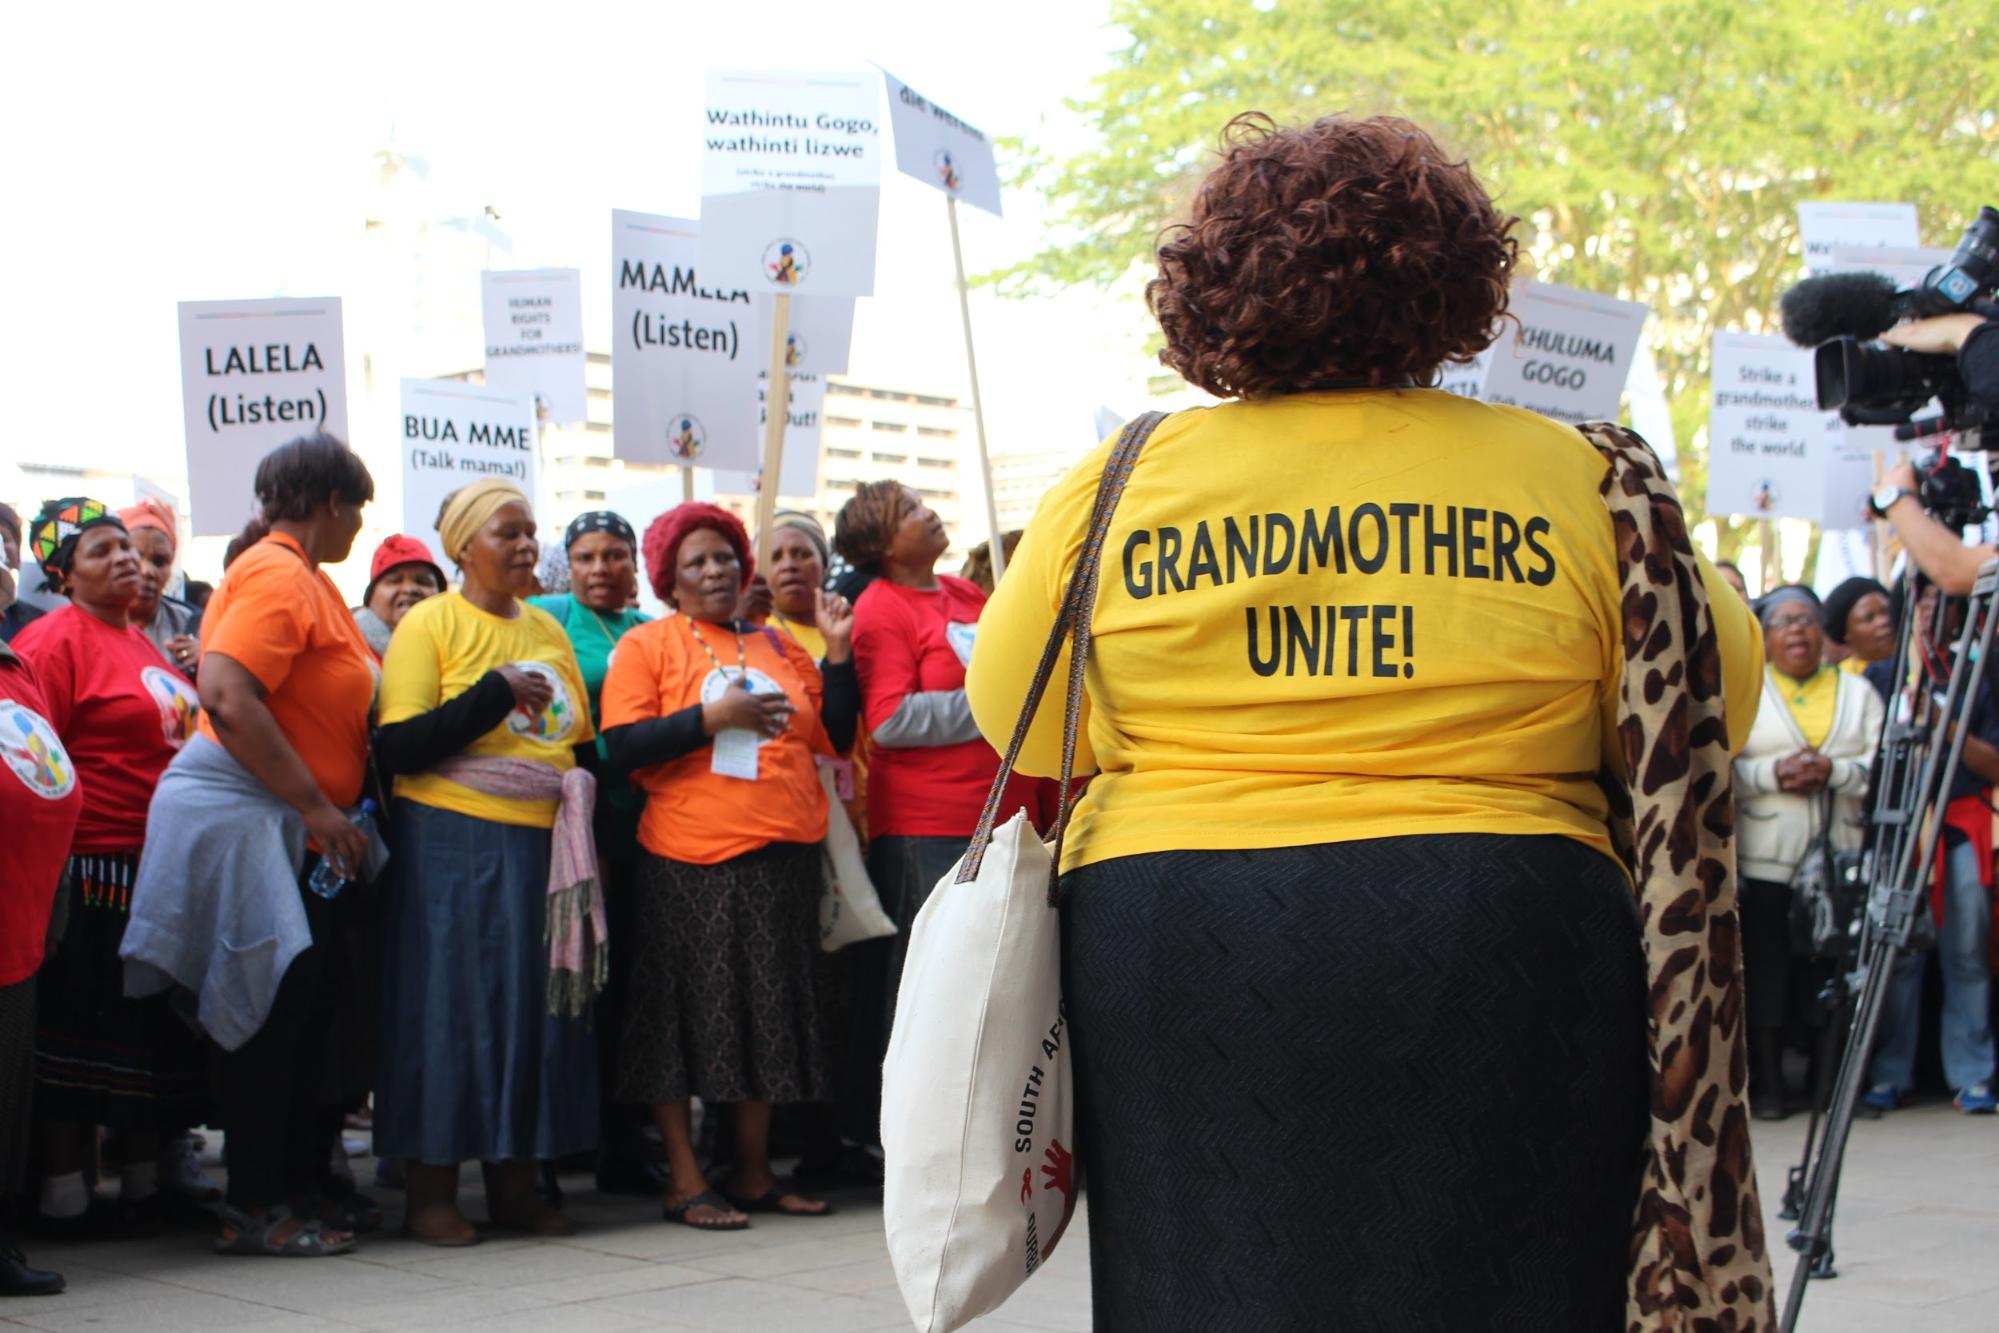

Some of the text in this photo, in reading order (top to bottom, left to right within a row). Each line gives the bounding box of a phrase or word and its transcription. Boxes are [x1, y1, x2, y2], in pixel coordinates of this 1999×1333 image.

[707, 108, 879, 135] Wathintu Gogo,
[706, 137, 865, 158] wathinti lizwe
[633, 308, 739, 361] (Listen)
[205, 342, 324, 376] LALELA
[1521, 358, 1587, 392] GOGO
[1738, 364, 1797, 385] Strike a
[208, 387, 327, 433] (Listen)
[1744, 415, 1787, 432] strike
[404, 414, 531, 452] BUA MME
[1731, 437, 1805, 458] the world
[412, 448, 527, 480] (Talk mama!)
[1122, 502, 1556, 599] GRANDMOTHERS
[1245, 604, 1415, 680] UNITE!
[1014, 1065, 1045, 1153] SOUTH
